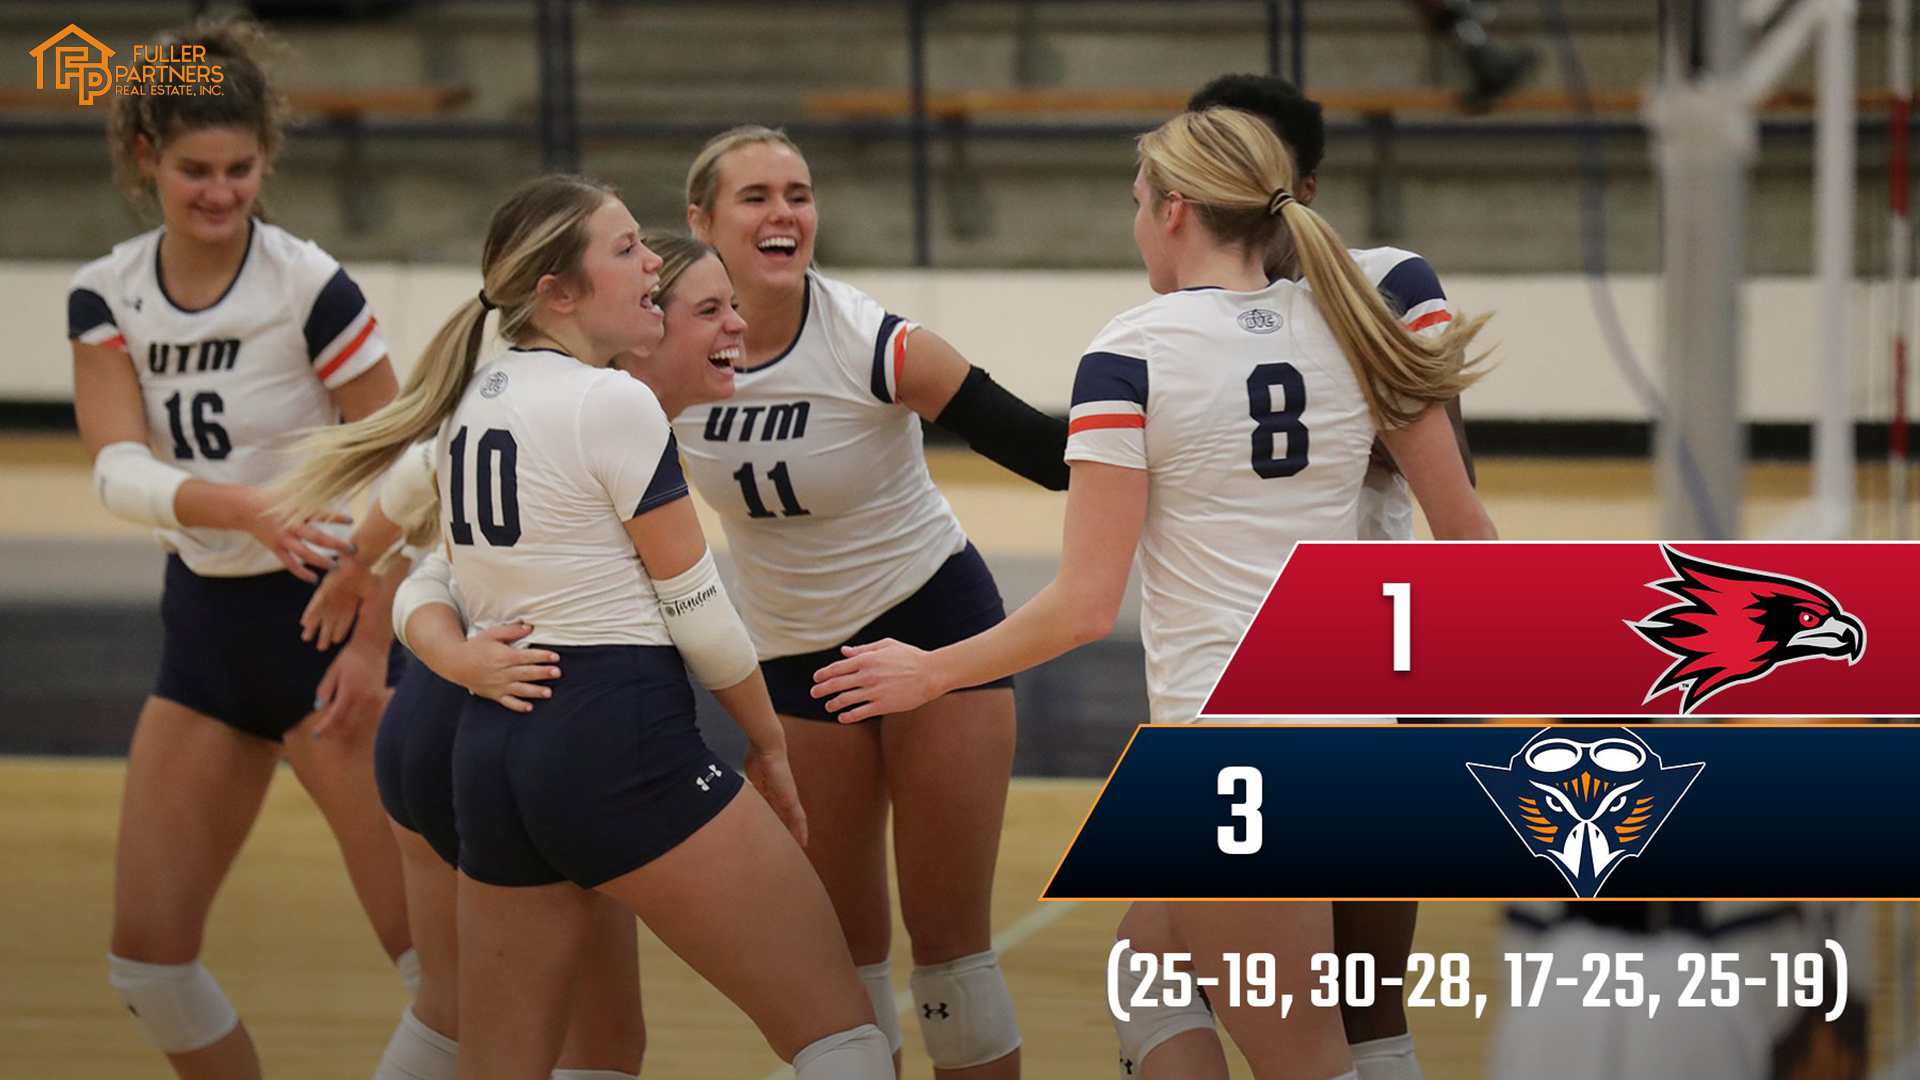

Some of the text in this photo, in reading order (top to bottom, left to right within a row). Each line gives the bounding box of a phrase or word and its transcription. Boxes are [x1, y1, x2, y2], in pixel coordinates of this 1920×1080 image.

[148, 338, 240, 374] UTM
[164, 391, 232, 461] 16
[703, 401, 811, 442] UTM
[1246, 361, 1309, 479] 8
[449, 425, 522, 547] 10
[732, 460, 811, 519] 11
